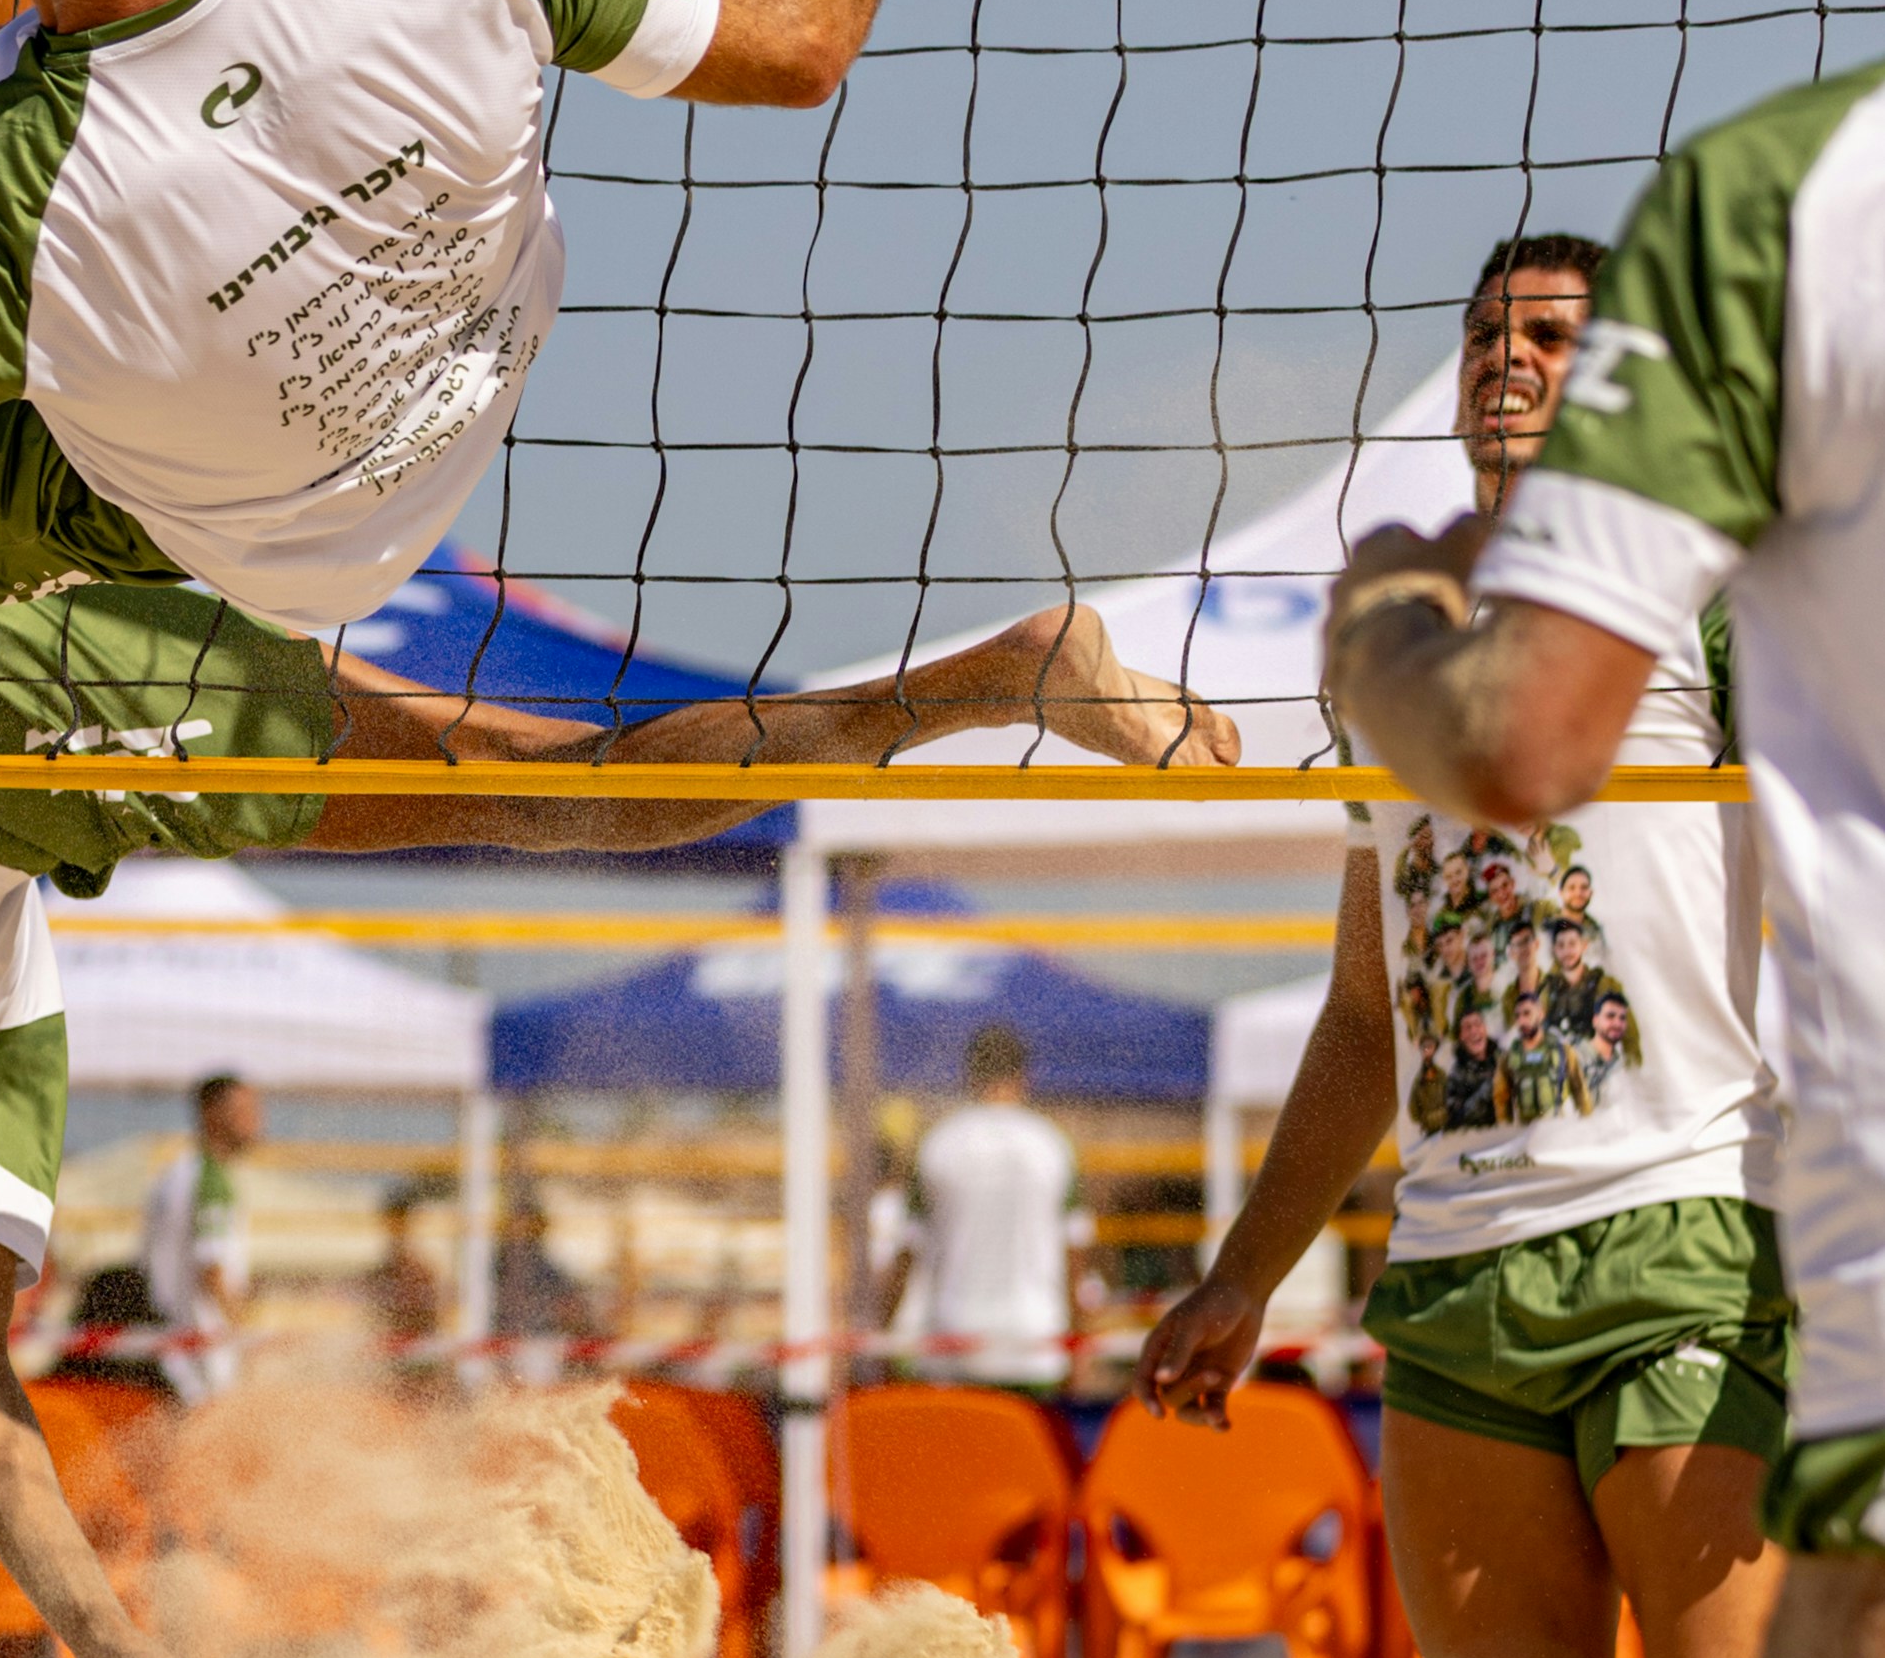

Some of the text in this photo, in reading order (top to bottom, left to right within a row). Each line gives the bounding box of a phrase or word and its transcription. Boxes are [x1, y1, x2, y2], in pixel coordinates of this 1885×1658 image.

[207, 139, 425, 313] לזכר גיבורינו
[395, 230, 434, 274] רס"ן
[422, 228, 467, 270] סמ"ר
[450, 237, 486, 281] רס"ן
[247, 193, 449, 357] סמ"ר שחר פרידמן ז"ל
[328, 304, 350, 329] לוי
[292, 333, 323, 359] ז"ל
[319, 309, 381, 374] כרמיאל
[279, 375, 312, 400] ז"ל
[320, 357, 368, 401] פימה
[281, 403, 316, 426] ז"ל
[318, 405, 348, 431] ז"ל
